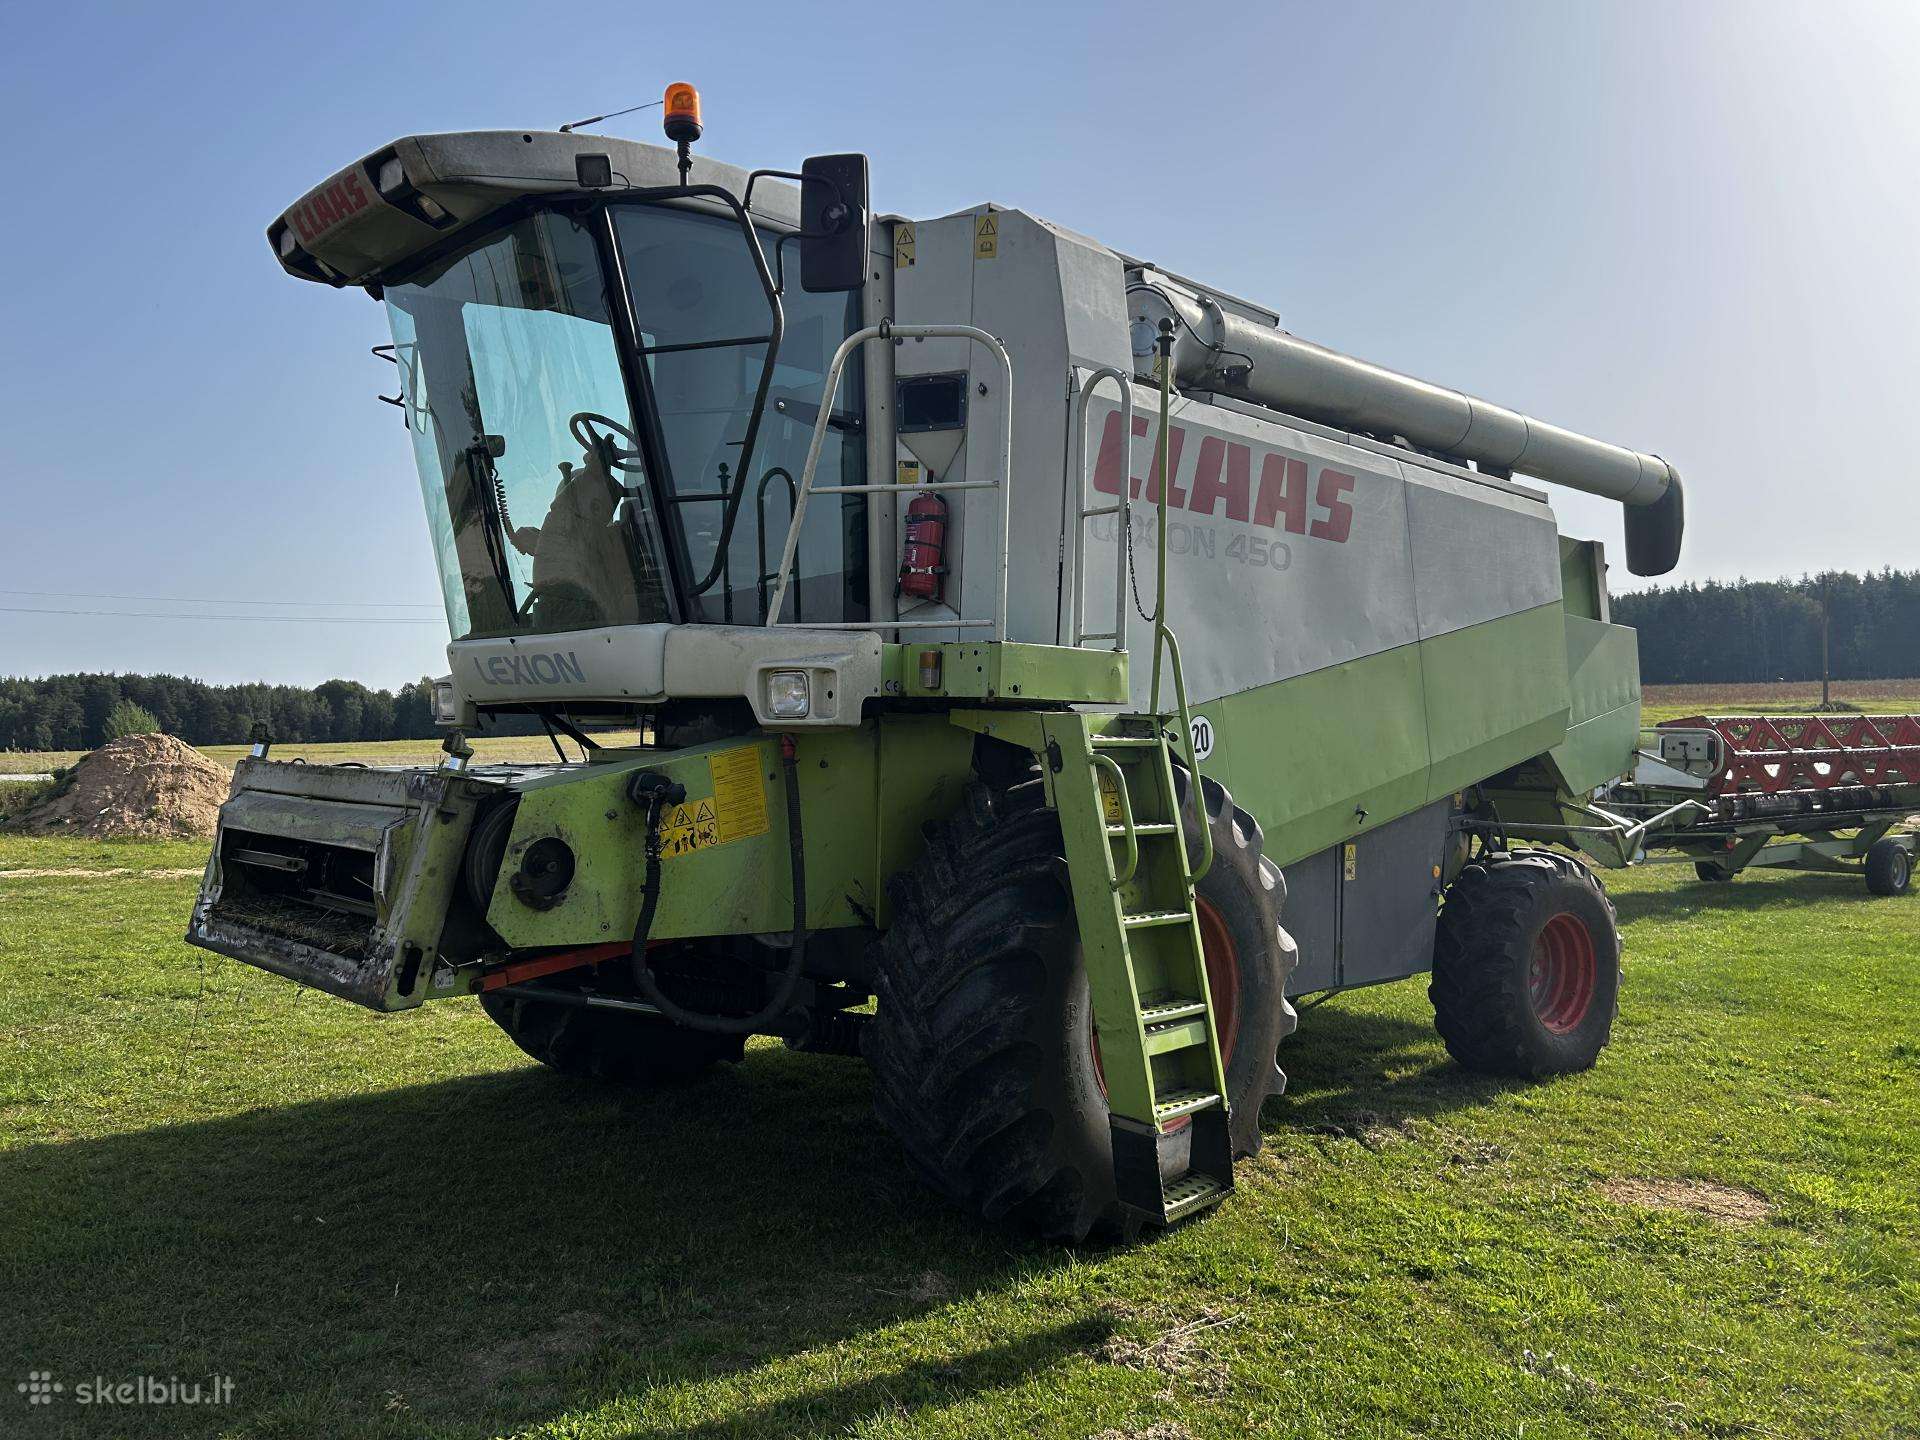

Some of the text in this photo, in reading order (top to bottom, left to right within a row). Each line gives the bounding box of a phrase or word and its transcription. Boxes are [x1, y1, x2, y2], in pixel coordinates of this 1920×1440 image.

[291, 169, 369, 242] CLAAS
[1093, 409, 1356, 544] CLAAS
[1224, 532, 1292, 572] 450
[473, 651, 587, 685] LEXION
[1191, 722, 1210, 754] 20
